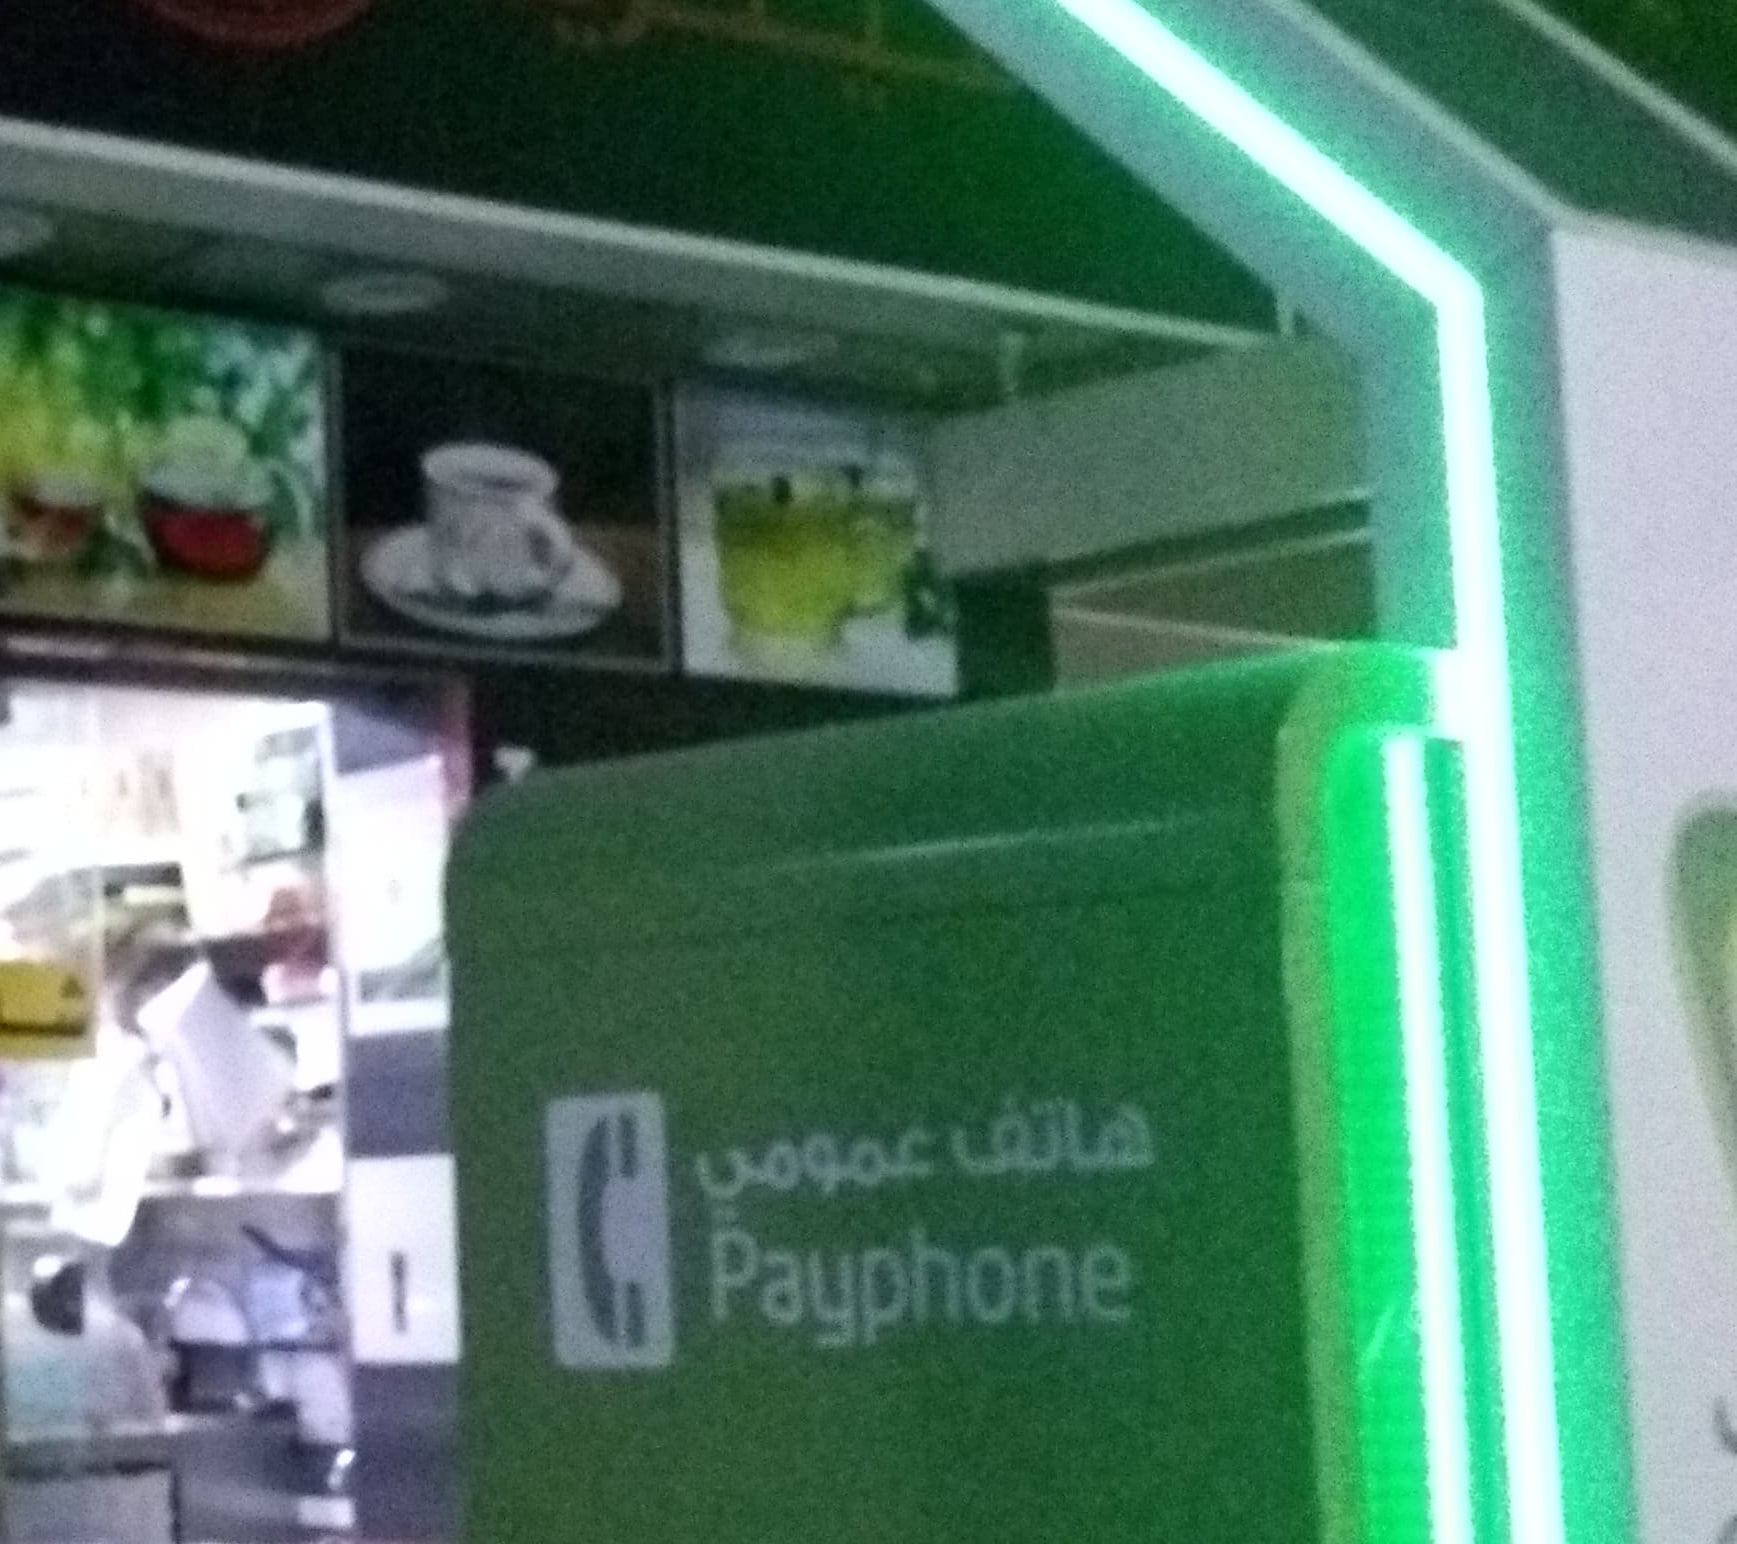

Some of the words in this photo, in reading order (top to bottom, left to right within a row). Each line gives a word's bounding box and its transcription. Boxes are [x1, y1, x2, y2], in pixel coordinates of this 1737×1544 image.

[696, 1126, 935, 1222] عمومي
[951, 1094, 1156, 1174] هاتف
[710, 1224, 1135, 1351] Payphone
